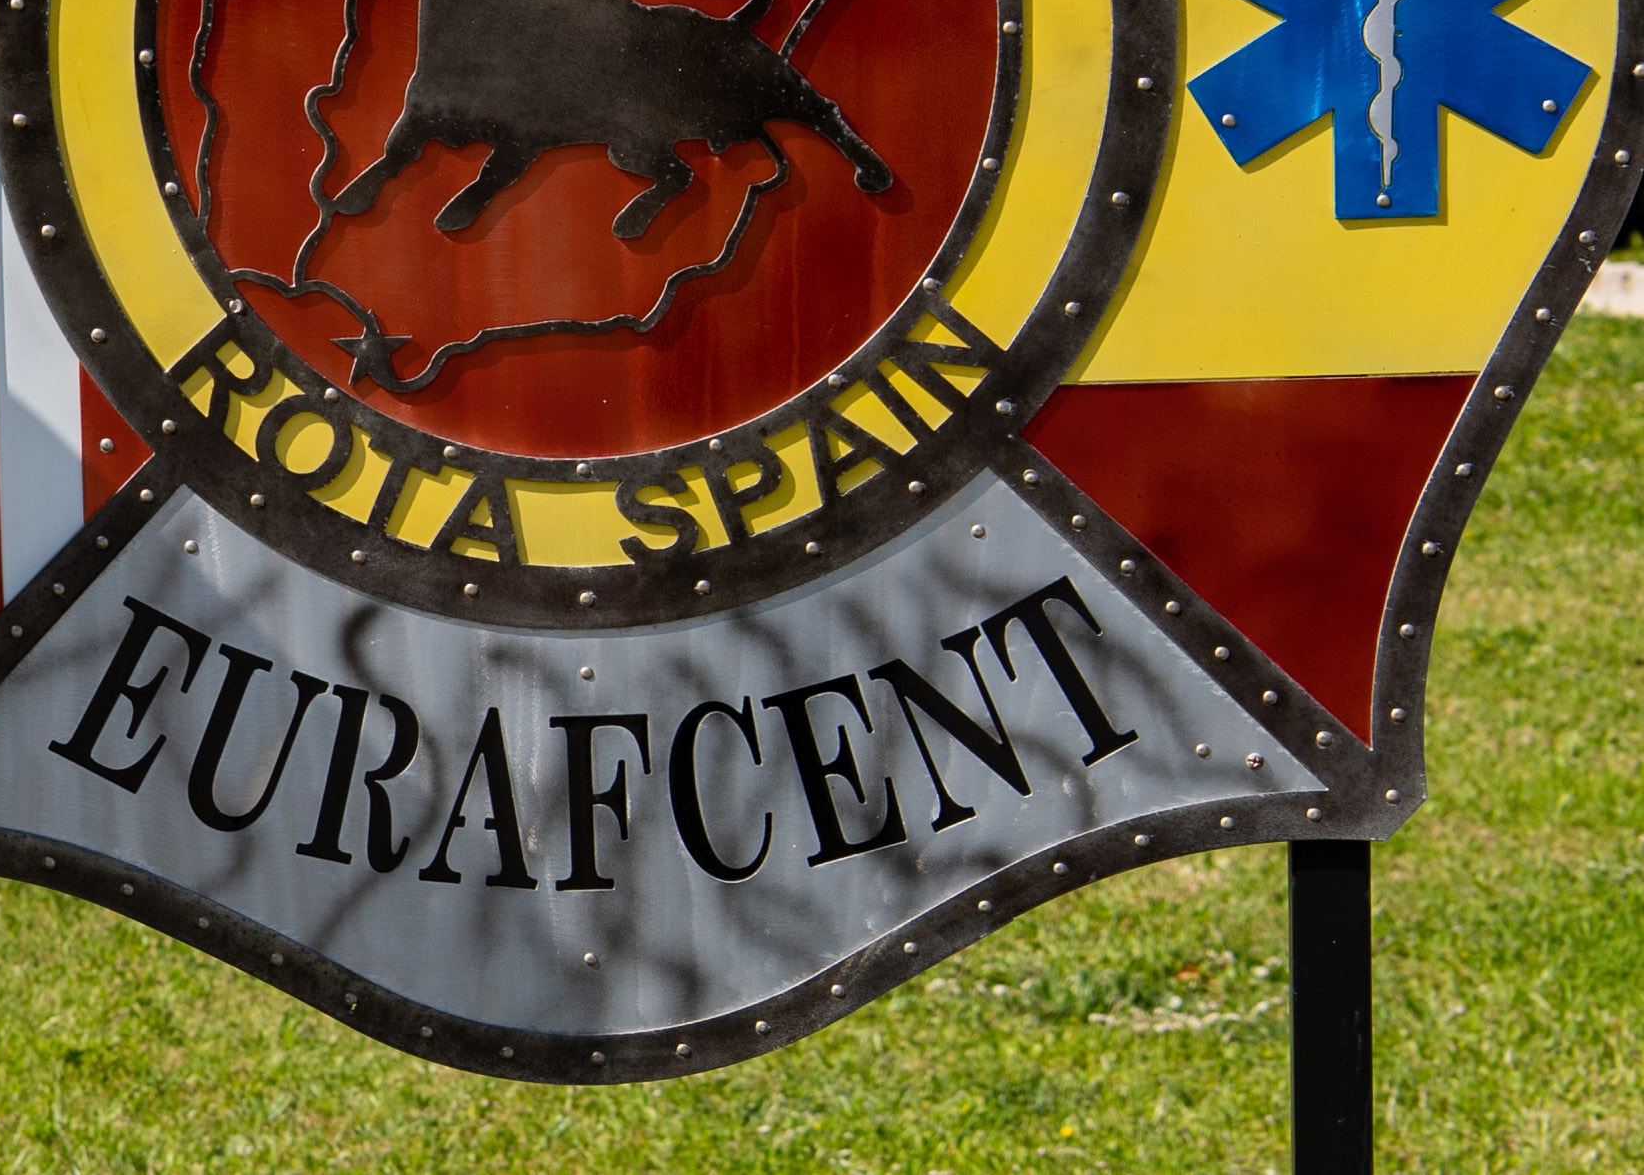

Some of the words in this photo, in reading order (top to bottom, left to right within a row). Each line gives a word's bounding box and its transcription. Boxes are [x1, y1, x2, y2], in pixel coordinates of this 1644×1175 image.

[174, 337, 522, 561] ROTA
[617, 312, 1001, 561] SPAIN
[49, 576, 1138, 890] EURAFCENT
